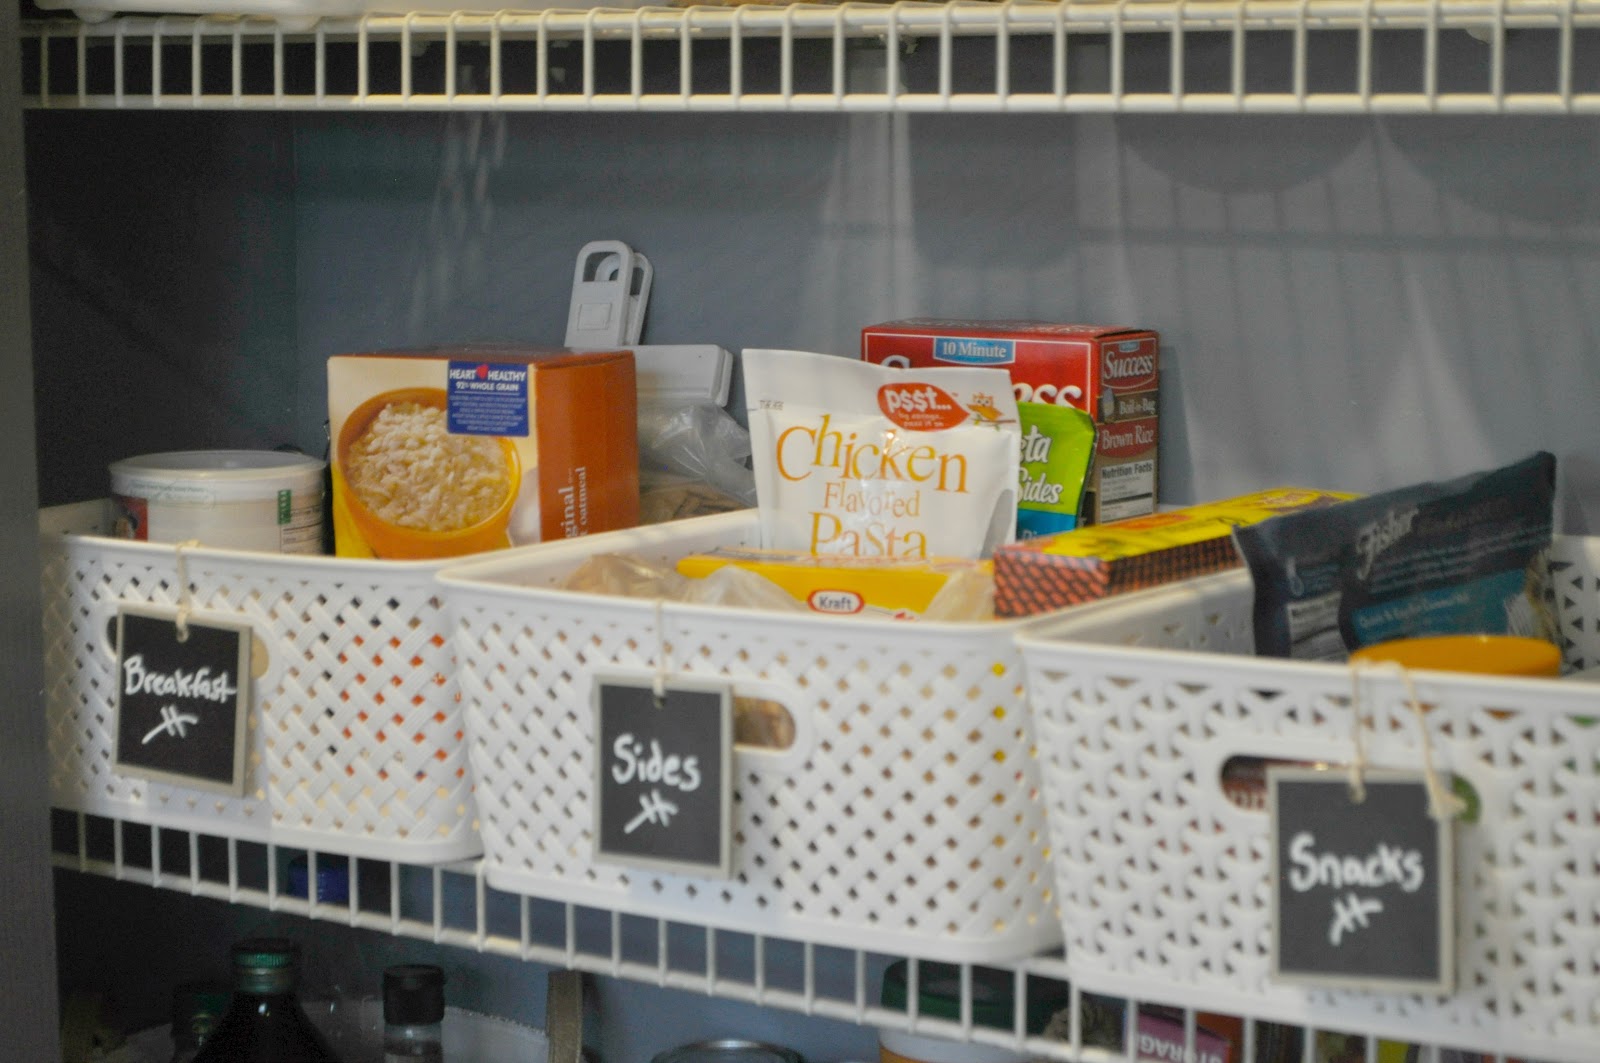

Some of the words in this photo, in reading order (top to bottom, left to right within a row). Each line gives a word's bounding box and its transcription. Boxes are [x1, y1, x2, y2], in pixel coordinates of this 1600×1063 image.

[942, 341, 958, 356] 10
[959, 342, 1007, 358] Minute
[1104, 351, 1154, 379] Success
[449, 369, 476, 380] HEART
[488, 370, 526, 382] HEALTHY
[470, 382, 495, 391] WHOLE
[496, 383, 519, 391] GRAIN
[775, 414, 969, 493] Chicken
[1102, 429, 1133, 450] Brown
[1135, 425, 1154, 444] Rice
[1134, 462, 1152, 474] Facts
[575, 466, 587, 525] oatmeal
[823, 481, 921, 517] Flavored
[808, 511, 929, 558] Pasta
[818, 595, 853, 610] Kraft
[123, 654, 237, 703] Breakfast
[611, 732, 702, 792] Sides
[1289, 830, 1425, 893] Snacks
